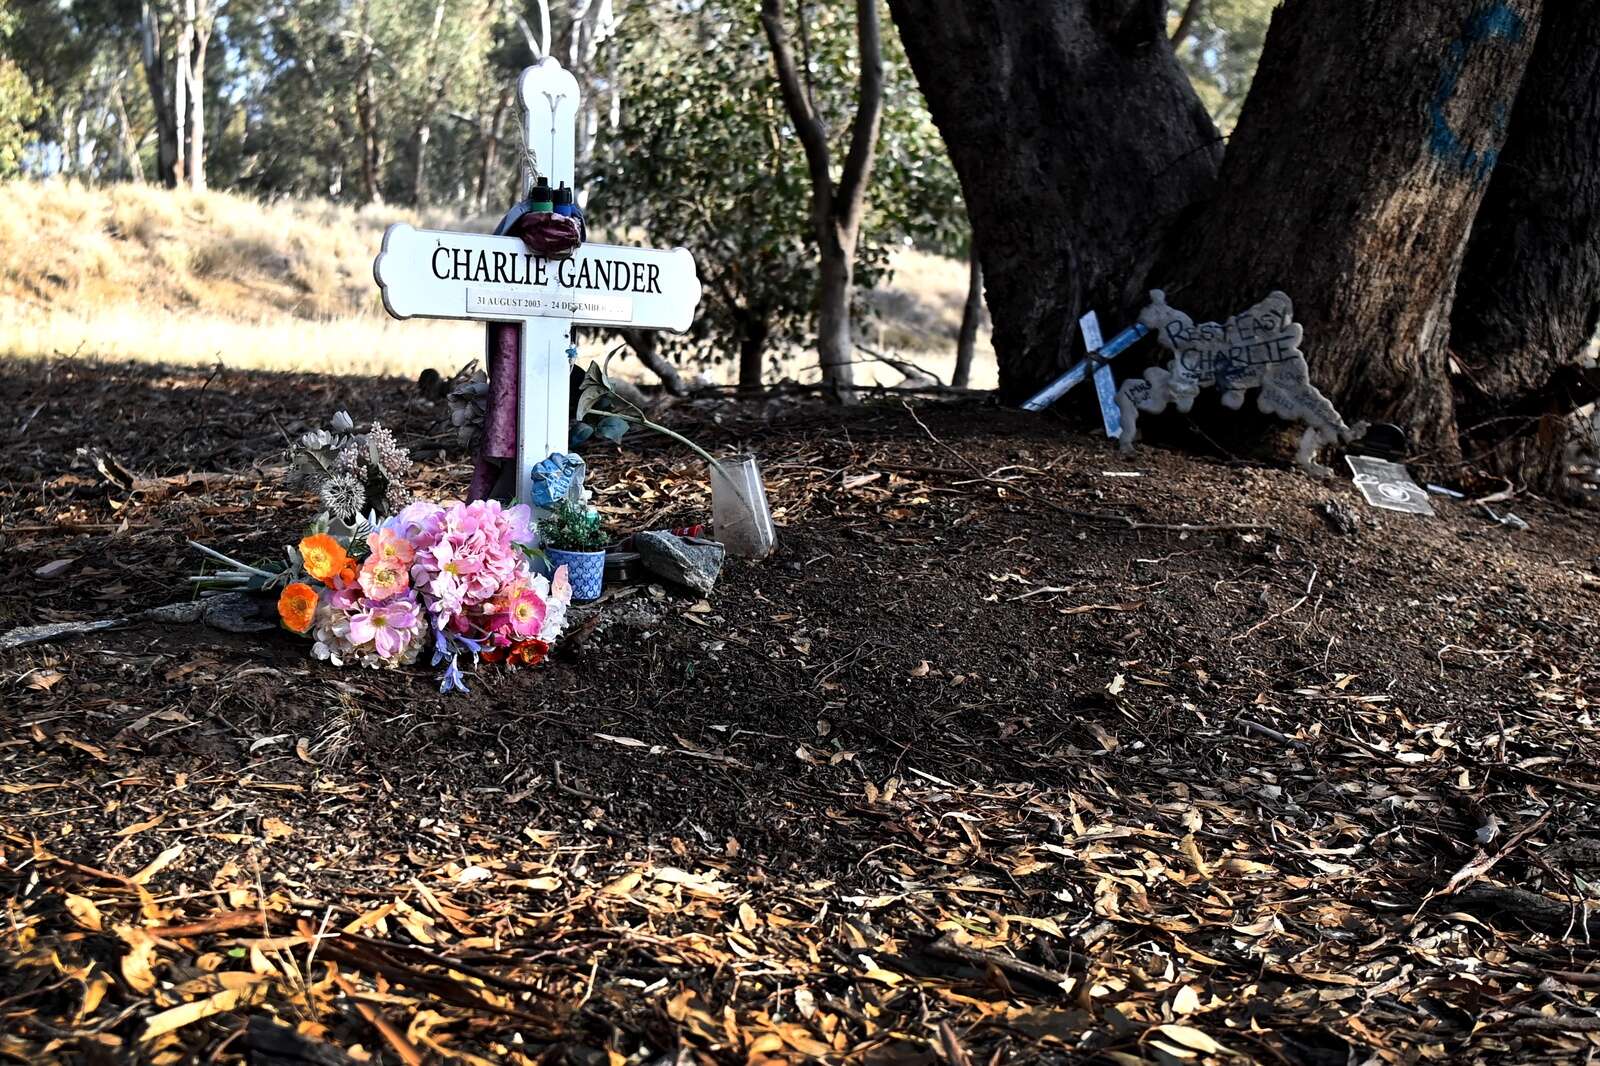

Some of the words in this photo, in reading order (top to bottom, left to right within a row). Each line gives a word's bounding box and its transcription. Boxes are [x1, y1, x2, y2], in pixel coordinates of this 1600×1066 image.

[432, 246, 548, 286] CHARLIE
[557, 257, 662, 294] GANDER
[477, 296, 485, 305] 31
[487, 297, 522, 307] AUGUST
[524, 299, 541, 308] 2003
[551, 301, 560, 309] 24
[561, 302, 606, 312] DEEMBER
[1167, 320, 1230, 348] REST
[1236, 308, 1288, 341] EASY
[1181, 336, 1298, 372] CHARLIE
